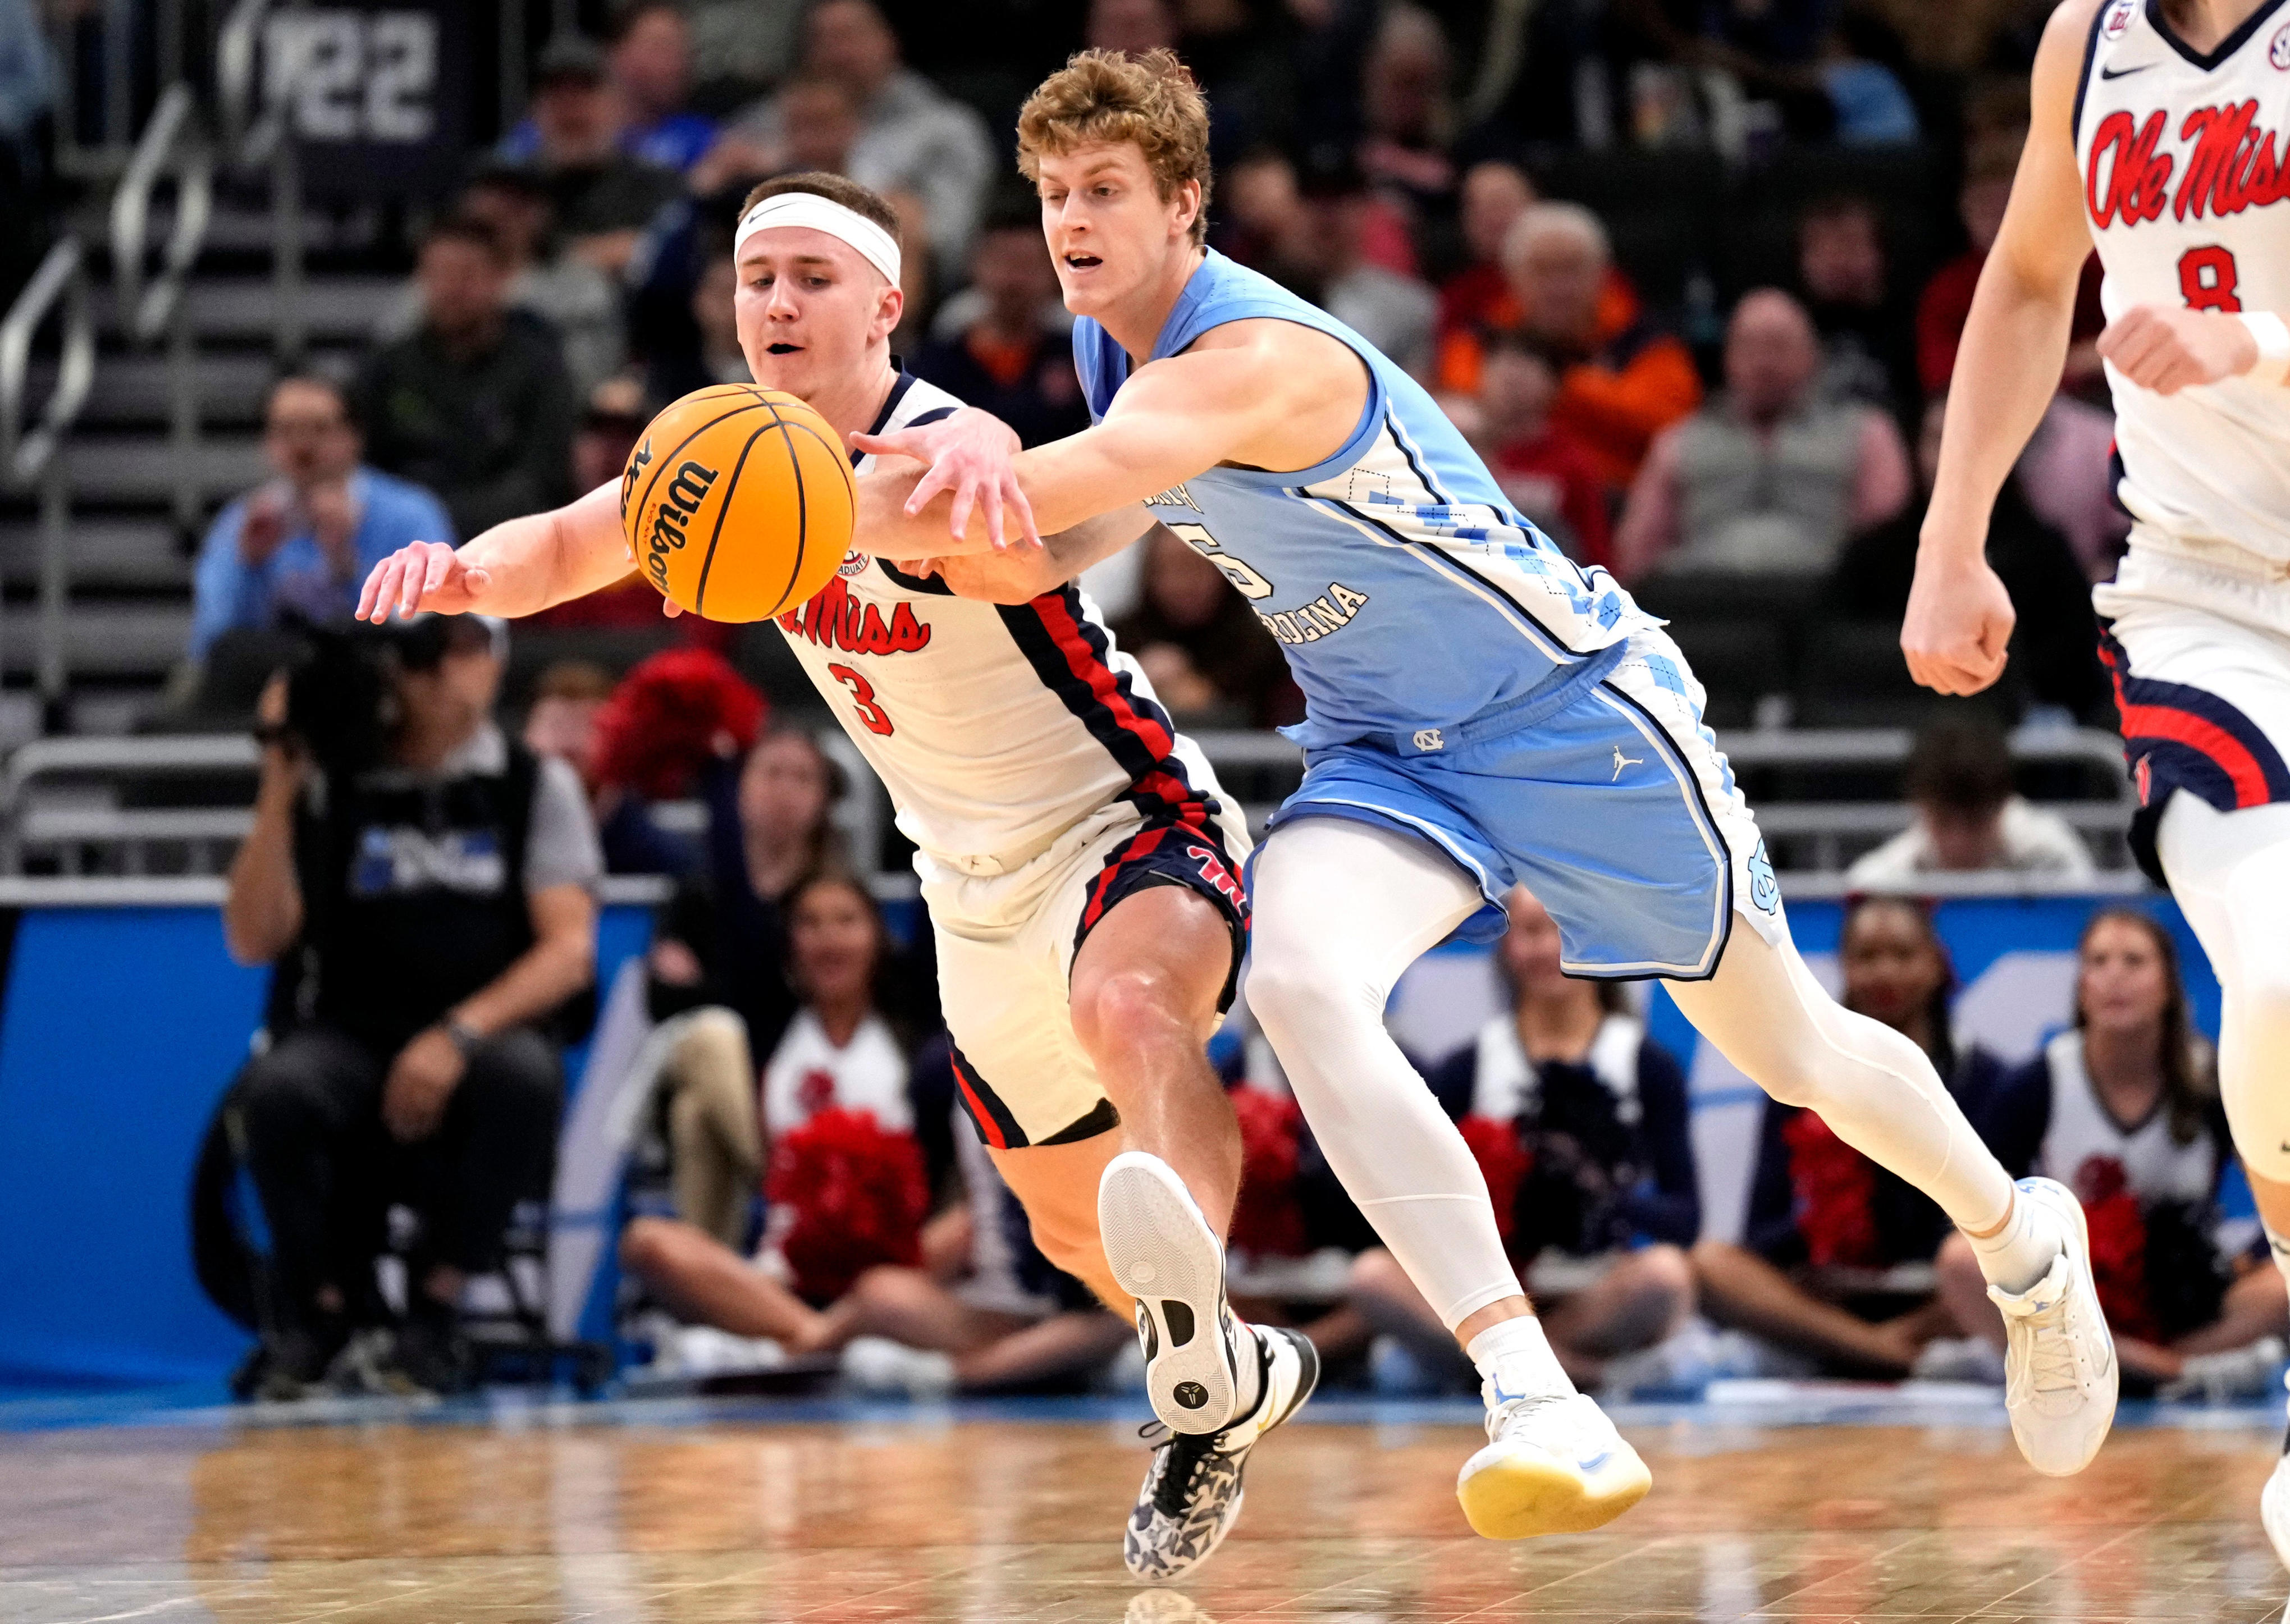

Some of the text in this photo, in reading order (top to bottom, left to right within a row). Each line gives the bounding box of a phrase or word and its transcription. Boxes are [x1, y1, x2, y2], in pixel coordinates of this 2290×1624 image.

[2087, 110, 2173, 231] Ole
[2178, 245, 2242, 314] 8
[648, 460, 719, 594] Wilson
[838, 555, 867, 575] ADUATE
[1166, 523, 1274, 601] 5
[803, 574, 931, 656] Miss
[1251, 582, 1369, 645] ROLINA
[828, 662, 894, 737] 3
